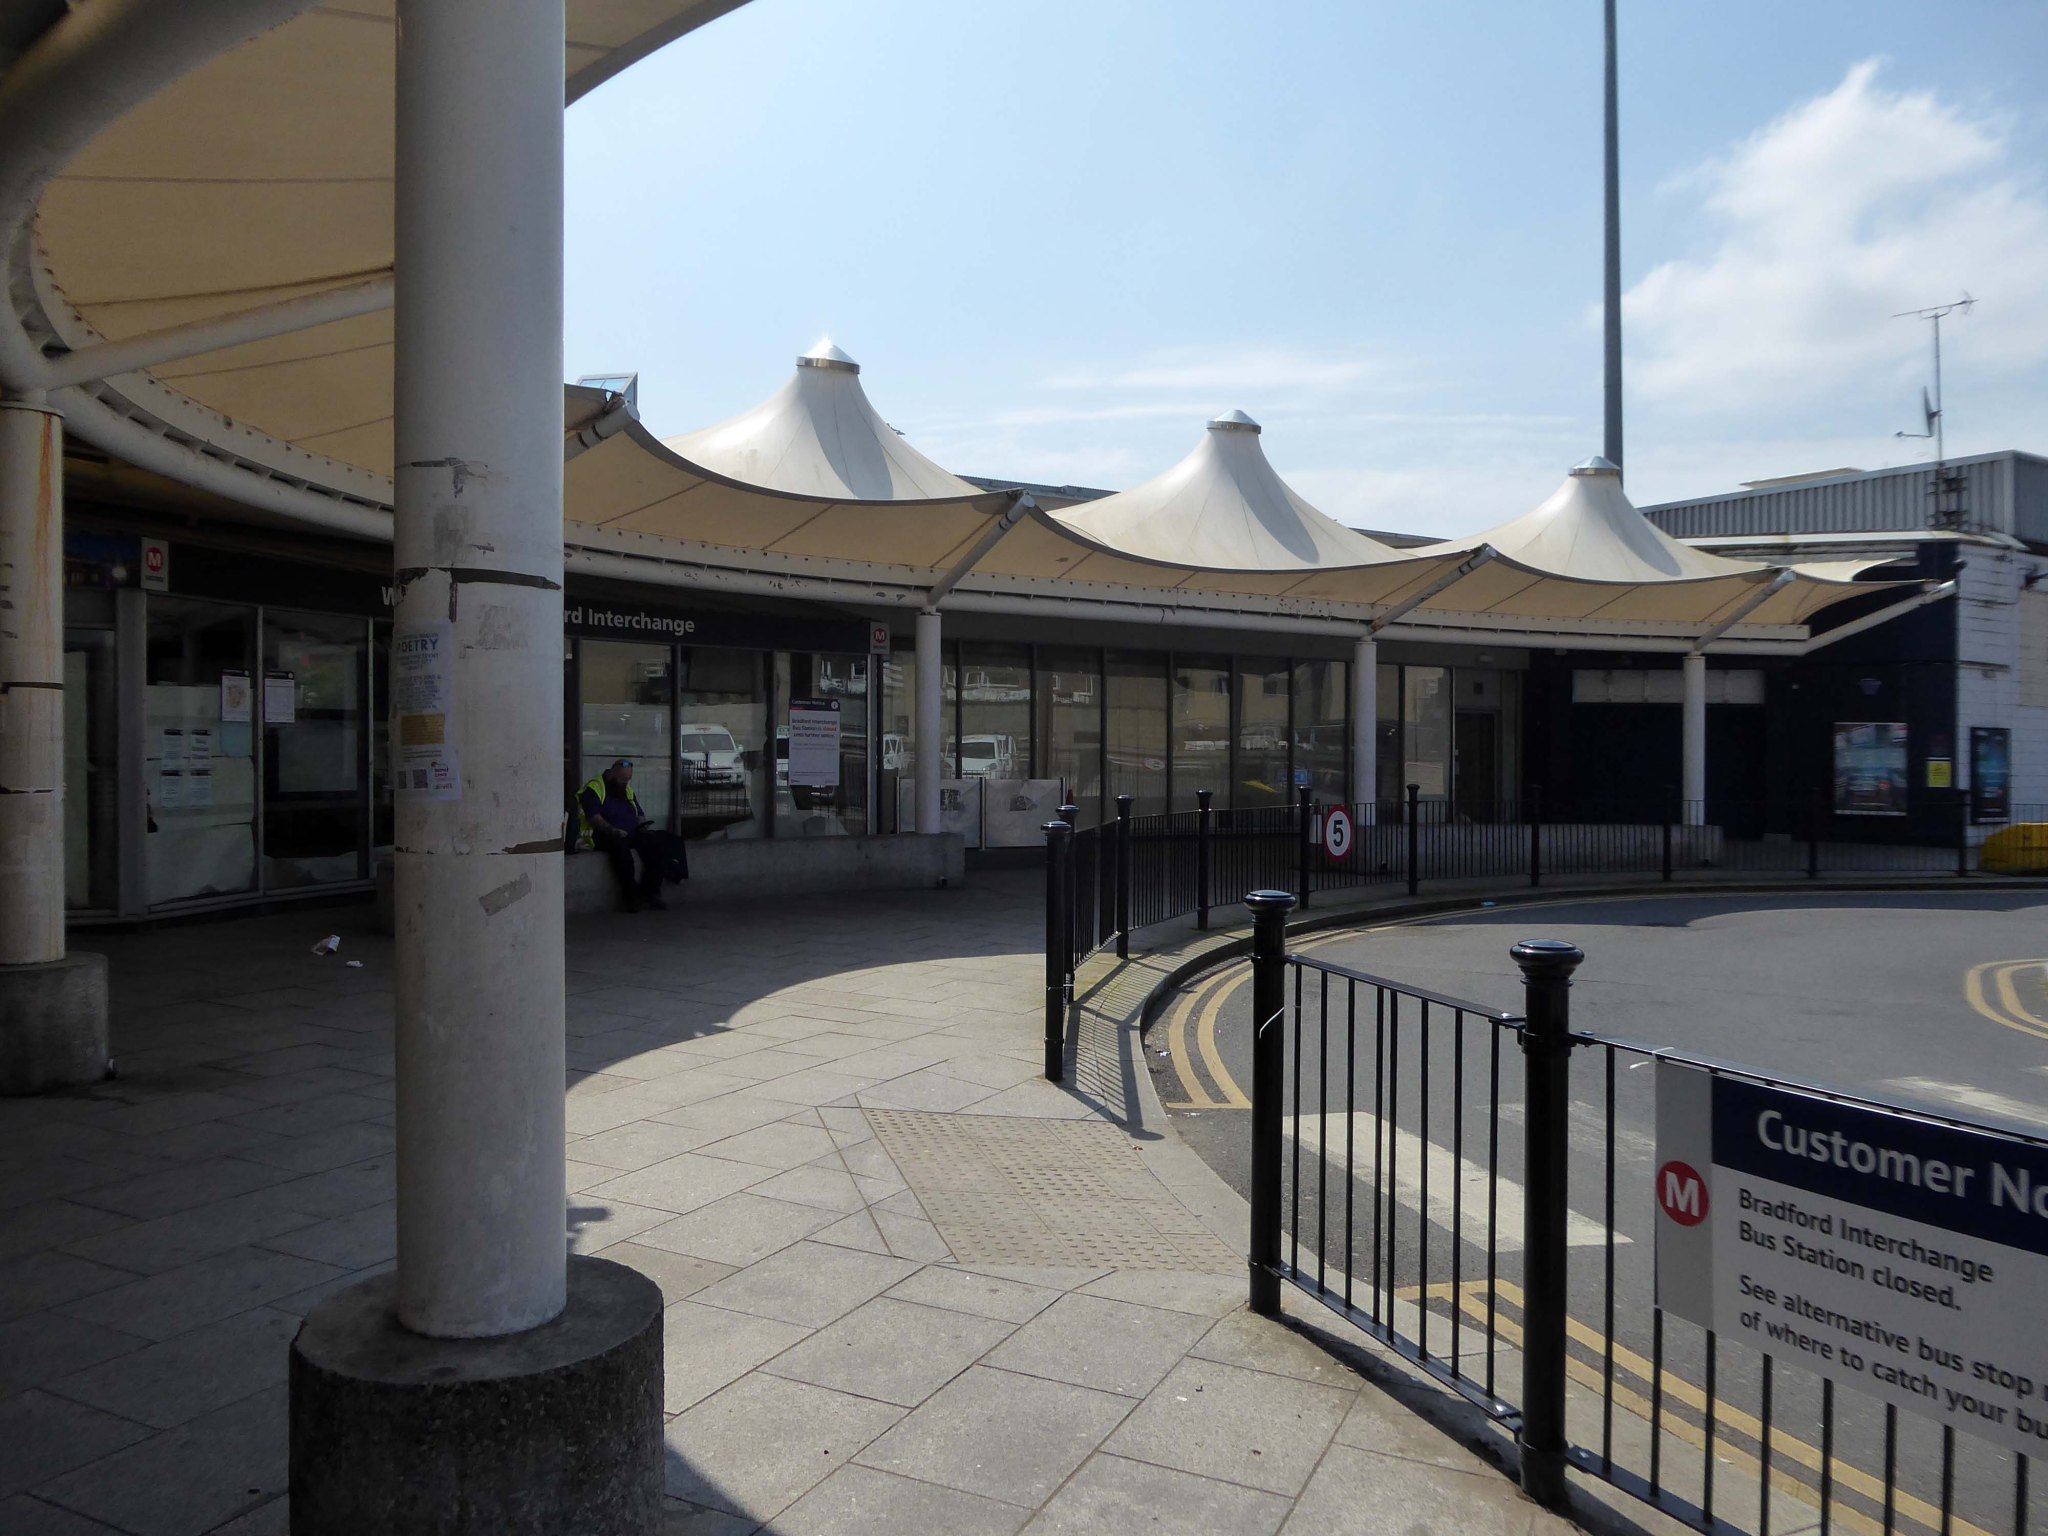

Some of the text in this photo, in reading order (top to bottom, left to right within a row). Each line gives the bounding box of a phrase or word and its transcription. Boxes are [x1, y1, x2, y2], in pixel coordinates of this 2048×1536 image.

[147, 552, 161, 567] M
[588, 608, 696, 636] Interchange
[875, 631, 885, 641] M
[1333, 820, 1344, 847] 5
[1757, 1109, 1975, 1198] Customer
[1664, 1171, 1699, 1218] M
[1739, 1187, 1994, 1284] Bradford Interchange
[1739, 1220, 1963, 1311] Bus Station closed.
[1739, 1273, 1777, 1306] See
[1782, 1293, 1910, 1353] alternative
[1918, 1336, 1964, 1373] bus
[1970, 1360, 2035, 1400] stop
[1739, 1311, 1762, 1332] of
[1766, 1322, 1833, 1360] where
[1839, 1346, 1865, 1372] to
[1872, 1360, 1939, 1401] catch
[1943, 1387, 2009, 1424] your
